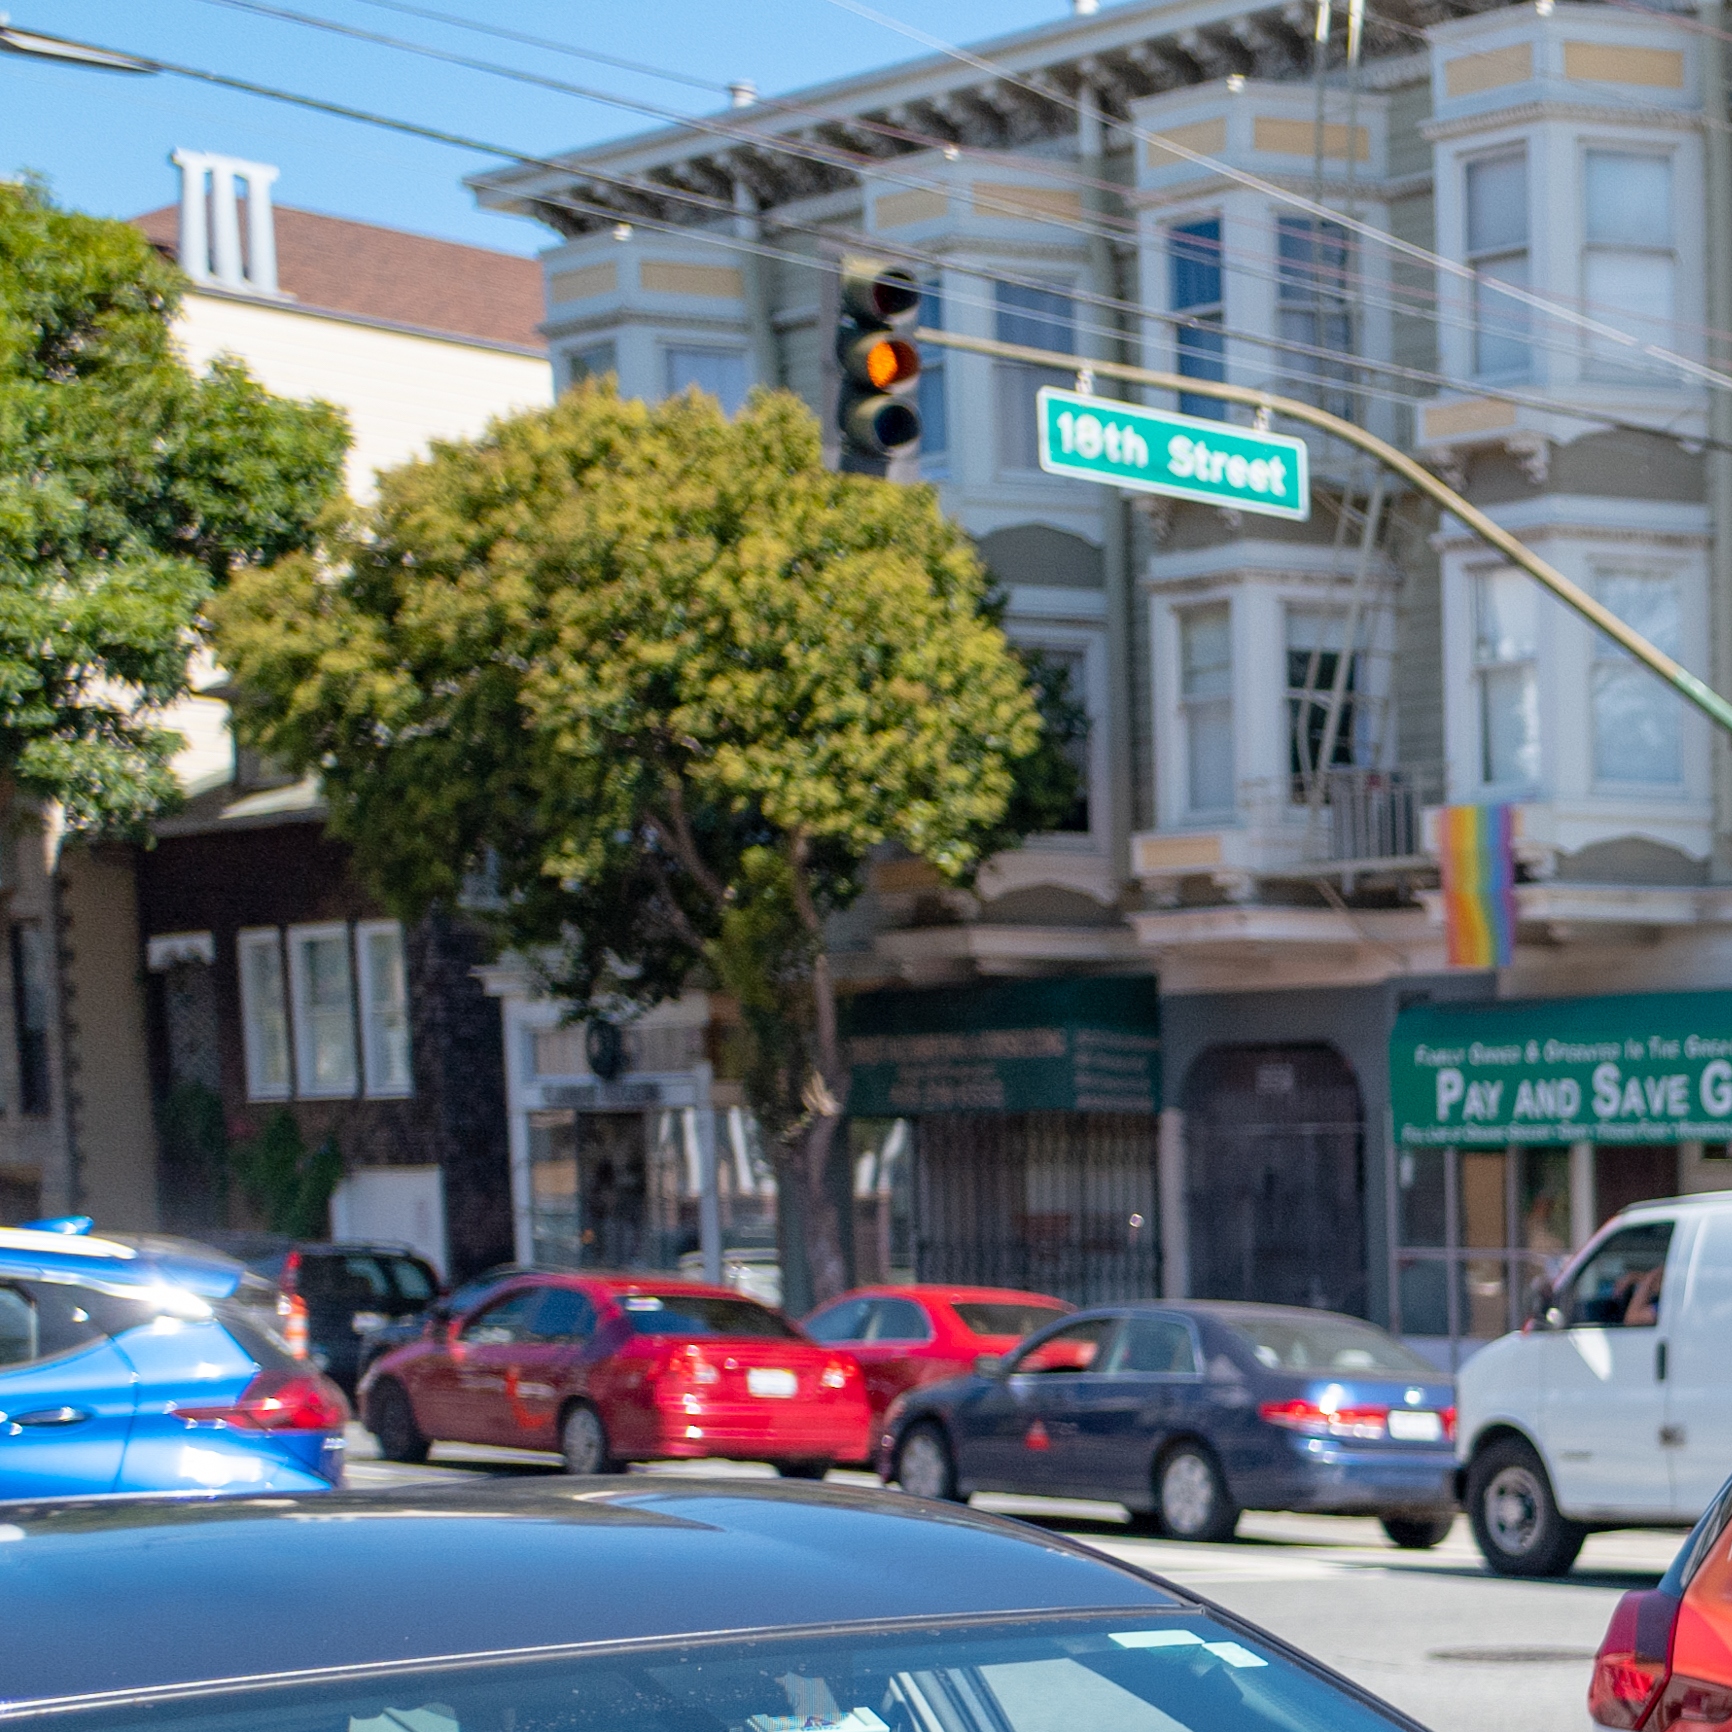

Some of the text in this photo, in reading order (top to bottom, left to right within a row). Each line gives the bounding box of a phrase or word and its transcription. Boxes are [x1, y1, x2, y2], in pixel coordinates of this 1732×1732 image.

[1056, 412, 1287, 496] 18th Street
[1436, 1067, 1504, 1122] PAY
[1513, 1078, 1581, 1120] AND
[1592, 1061, 1690, 1118] SAVE
